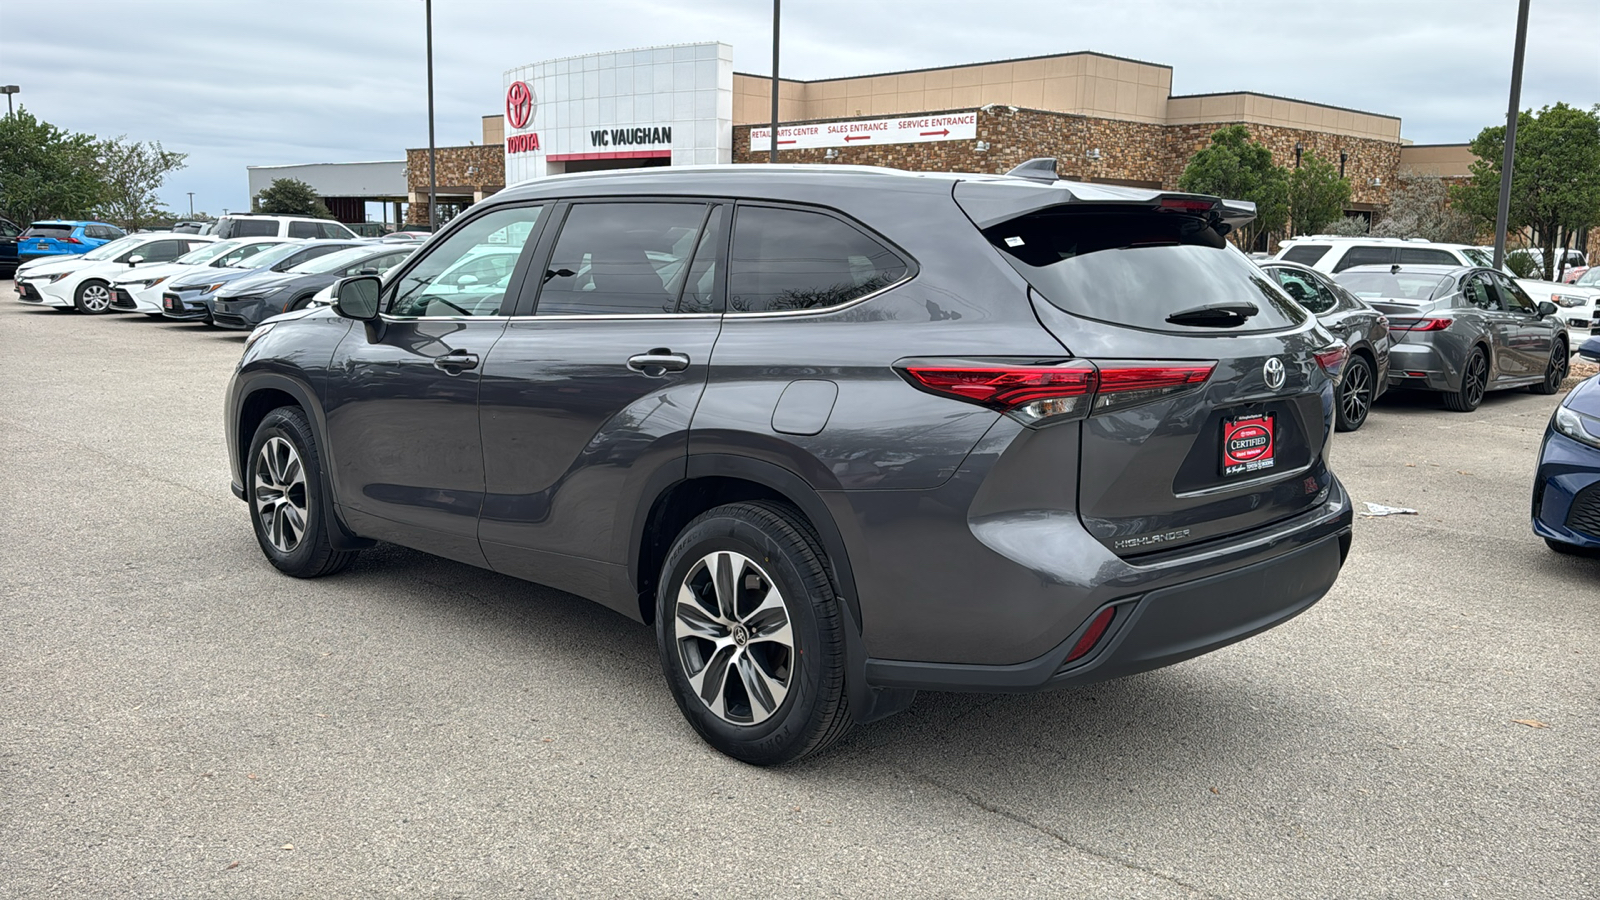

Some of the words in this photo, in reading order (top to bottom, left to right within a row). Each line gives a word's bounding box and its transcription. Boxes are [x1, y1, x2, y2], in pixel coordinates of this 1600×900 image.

[828, 125, 848, 134] SALES
[850, 122, 888, 133] ENTRANCE
[898, 119, 929, 129] SERVICE
[931, 115, 975, 127] ENTRANCE
[590, 129, 609, 147] VIC
[611, 126, 672, 146] VAUGHAN
[751, 130, 771, 139] RETAIL
[776, 128, 792, 137] ARTS
[793, 127, 819, 136] CENTER
[506, 132, 540, 154] TOYOTA
[1114, 529, 1190, 549] HIGHLANDER
